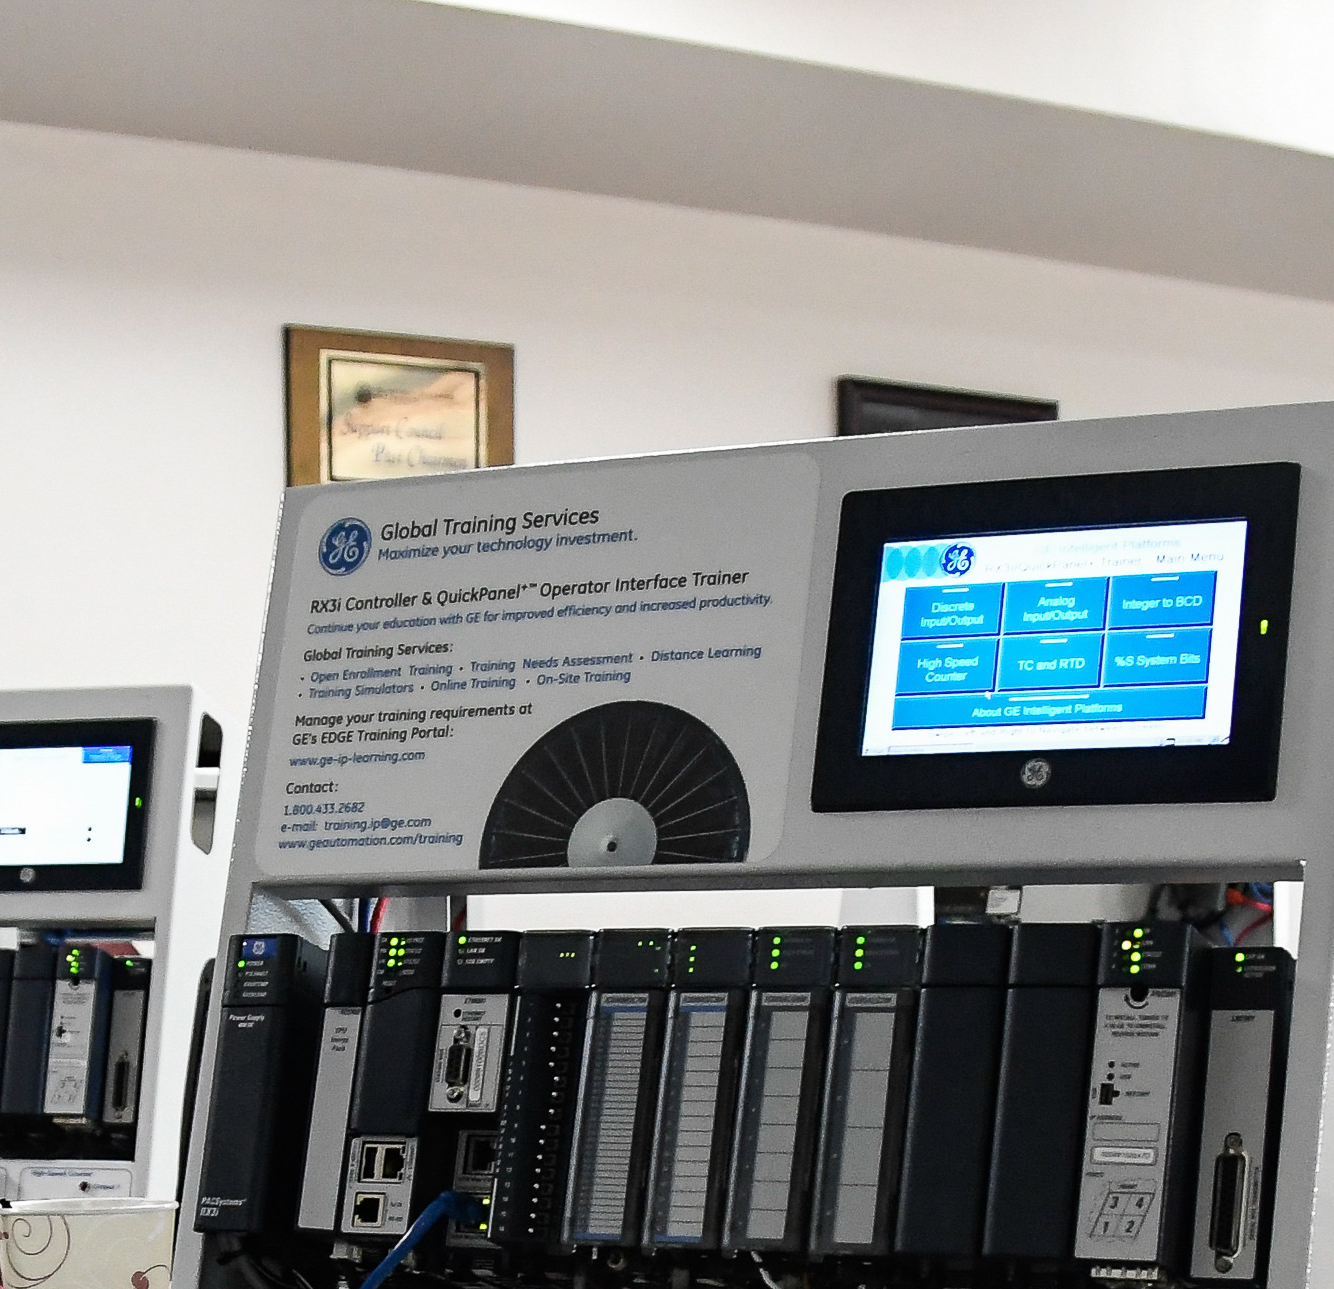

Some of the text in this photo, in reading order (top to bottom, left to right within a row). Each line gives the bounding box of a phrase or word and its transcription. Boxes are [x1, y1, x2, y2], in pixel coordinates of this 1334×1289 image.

[380, 507, 600, 541] Global Training Services
[378, 529, 638, 561] Maximize your technology investment.
[1122, 538, 1181, 551] Platforms
[1155, 553, 1185, 564] Main
[1190, 551, 1225, 562] Menu
[310, 597, 342, 614] RX3i
[346, 592, 418, 611] Controller
[422, 592, 433, 605] &
[540, 579, 611, 600] Operator
[615, 573, 688, 592] Interface
[692, 569, 749, 587] Trainer
[931, 600, 975, 613] Discrete
[1038, 595, 1076, 609] Analog
[1122, 595, 1203, 611] Integer to BCD
[307, 621, 354, 634] Continue
[355, 619, 381, 633] your
[383, 616, 437, 629] education
[439, 613, 463, 626] with
[466, 612, 480, 623] GE
[483, 610, 500, 622] for
[501, 606, 554, 622] improved
[557, 602, 611, 618] efficiency
[615, 600, 637, 614] and
[640, 597, 696, 612] increased
[921, 614, 984, 628] Input/Output
[1023, 608, 1089, 623] Input/Output
[303, 641, 454, 662] Global Training Services:
[310, 645, 762, 684] Open Enrollment Training Training Needs Assessment Distance Learning
[917, 656, 979, 671] High Speed
[1018, 657, 1086, 671] TC and RTD
[1136, 653, 1177, 668] System
[1179, 653, 1201, 665] Bits
[925, 670, 968, 683] Counter
[308, 670, 631, 700] Training Simulators Online Training On-Site Training
[295, 702, 533, 729] Manage your training requirements at
[972, 701, 1123, 718] About GE Intelligent Platforms
[292, 725, 454, 746] GE's EDGE Training Portal:
[285, 779, 339, 795] Contact:
[280, 820, 318, 833] e-mail:
[277, 832, 464, 851] www.geautomation.com/training
[1109, 1195, 1144, 1210] 3 4
[1102, 1220, 1135, 1234] 1 2
